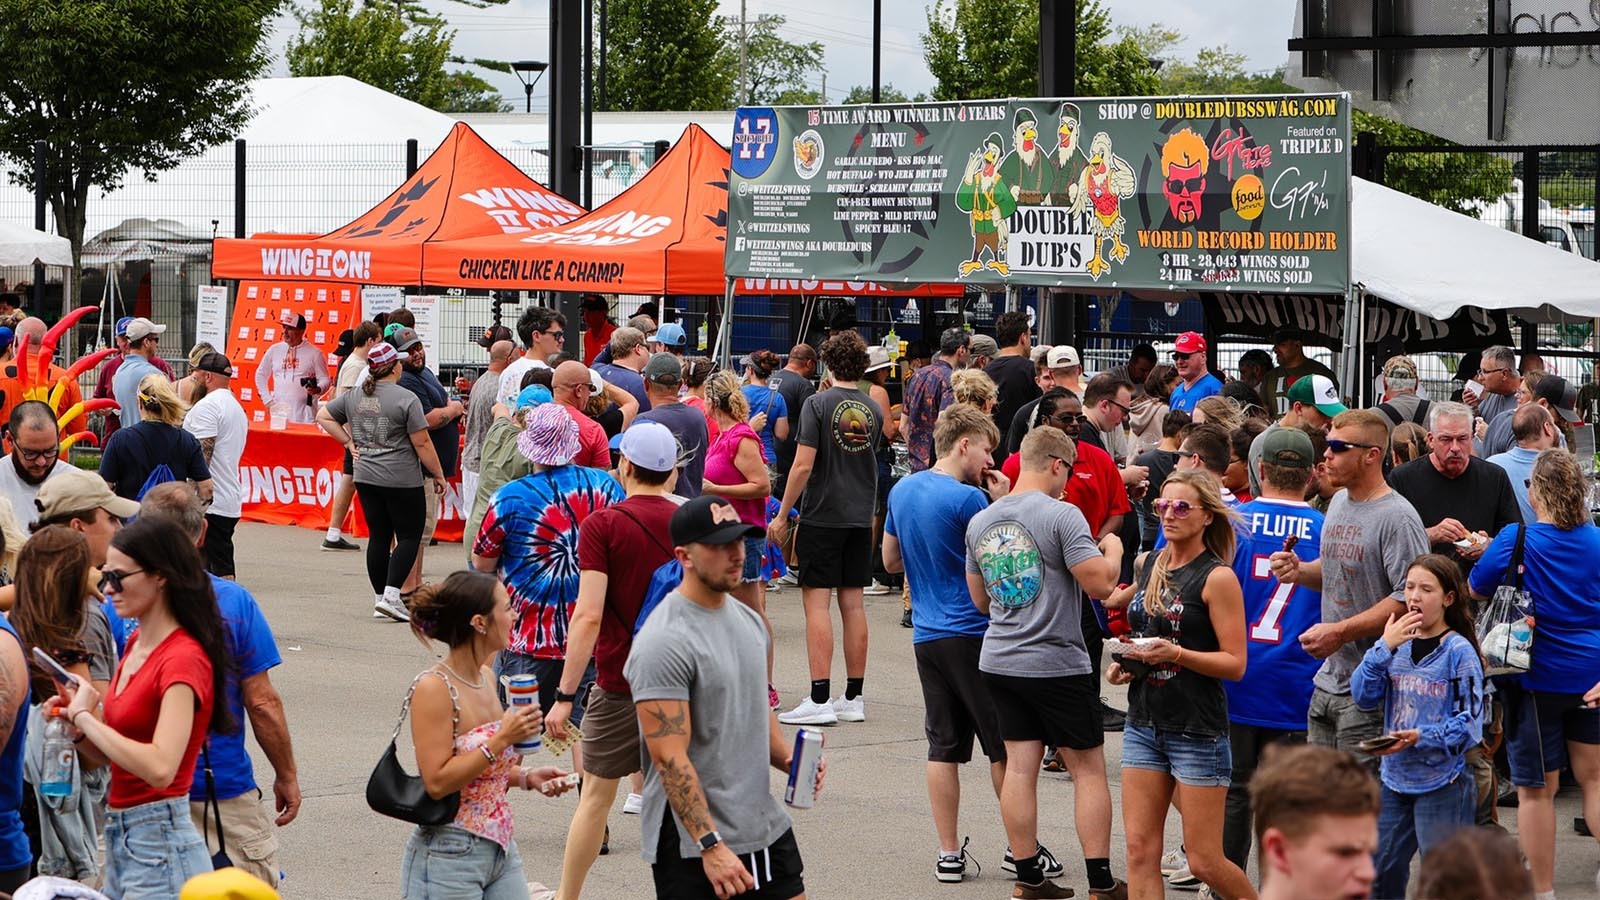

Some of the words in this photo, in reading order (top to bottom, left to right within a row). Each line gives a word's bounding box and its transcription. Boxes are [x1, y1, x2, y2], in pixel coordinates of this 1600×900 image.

[807, 109, 820, 126] 15
[822, 109, 849, 124] TIME
[851, 108, 891, 124] AWARD
[893, 107, 940, 123] WINNER
[943, 107, 956, 122] IN
[957, 106, 967, 122] 4
[968, 105, 1006, 121] YEARS
[1098, 102, 1138, 120] SHOP
[1154, 98, 1337, 120] DOUBLEDUBSSWAG.COM
[1287, 126, 1323, 137] Featured
[1324, 127, 1337, 136] on
[869, 132, 907, 148] MENU
[1280, 138, 1333, 154] TRIPLE
[1335, 138, 1343, 153] D
[834, 156, 859, 166] GARLIC
[860, 156, 892, 166] ALFREDO
[913, 155, 926, 165] BIG
[928, 155, 943, 165] MAC
[826, 170, 841, 180] HOT
[842, 170, 873, 180] BUFFALO
[894, 169, 914, 179] JERK
[915, 169, 931, 179] DRY
[932, 169, 948, 178] RUB
[909, 182, 943, 192] CHICKEN
[459, 187, 582, 214] WING
[872, 197, 896, 207] HONEY
[897, 197, 932, 207] MUSTARD
[1236, 185, 1263, 213] food
[833, 211, 851, 220] LIME
[851, 211, 879, 220] PEPPER
[884, 211, 902, 220] MILD
[904, 210, 937, 220] BUFFALO
[1009, 209, 1093, 235] DOUBLE
[903, 224, 912, 233] 17
[805, 241, 821, 251] AKA
[822, 241, 872, 252] DOUBLEDUBS
[1137, 230, 1193, 249] WORLD
[1197, 230, 1265, 250] RECORD
[1269, 231, 1337, 251] HOLDER
[260, 247, 315, 276] WING
[1020, 241, 1081, 268] DUB'S
[1162, 253, 1169, 266] 8
[1172, 254, 1189, 266] HR
[1198, 254, 1237, 269] 28,043
[1239, 255, 1278, 268] WINGS
[1280, 255, 1310, 269] SOLD
[459, 258, 520, 280] CHICKEN
[522, 260, 551, 280] LIKE
[554, 261, 565, 280] A
[567, 262, 625, 284] CHAMP!
[1159, 268, 1172, 281] 24
[1175, 269, 1192, 281] HR
[1243, 269, 1281, 283] WINGS
[1283, 270, 1313, 284] SOLD
[1252, 512, 1314, 540] FLUTIE
[1250, 553, 1303, 645] 7
